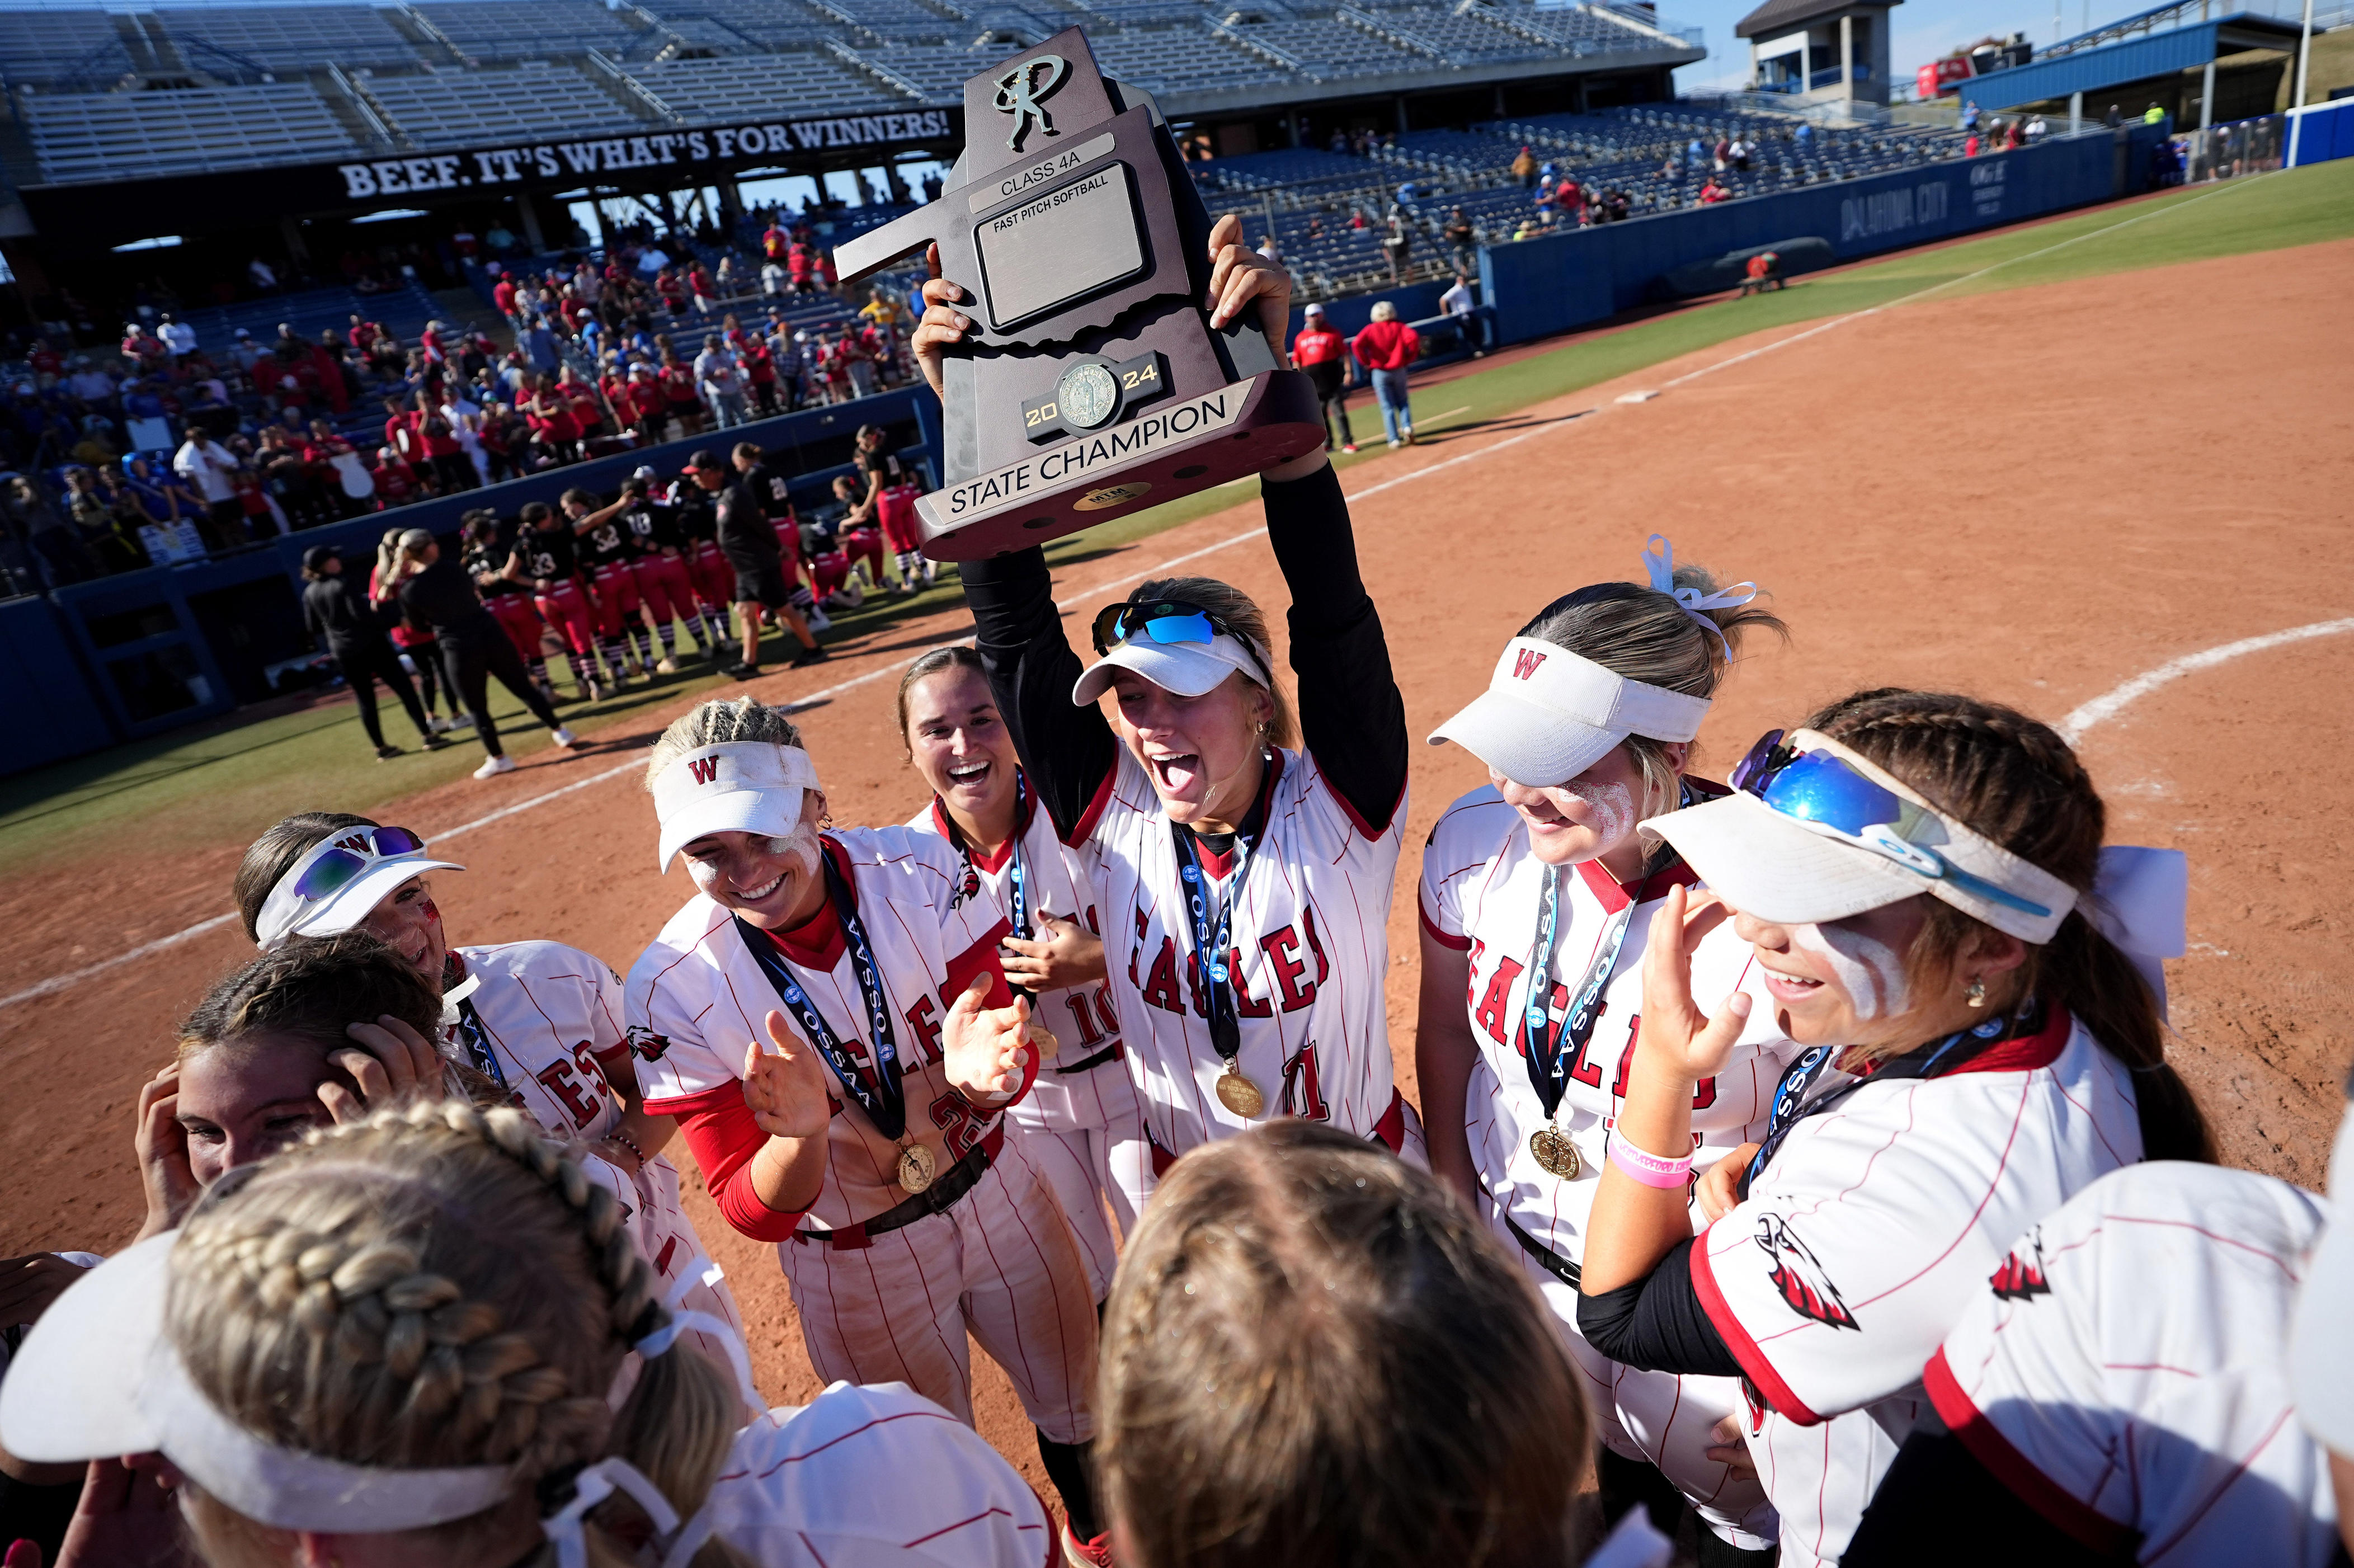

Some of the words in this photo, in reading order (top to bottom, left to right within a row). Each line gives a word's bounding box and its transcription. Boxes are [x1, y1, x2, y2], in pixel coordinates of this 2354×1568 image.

[341, 155, 472, 198] BEEF.
[473, 146, 559, 183] IT'S
[559, 131, 710, 173] WHAT'S
[713, 124, 793, 158] FOR
[790, 111, 950, 148] WINNERS!
[1002, 162, 1054, 196] CLASS
[1060, 152, 1080, 169] 4A
[994, 214, 1018, 233] FAST
[1021, 199, 1051, 220] PITCH
[1054, 176, 1108, 206] SOFTBALL
[1123, 364, 1157, 390] 24
[1025, 402, 1057, 427] 20
[951, 464, 1030, 514] STATE
[1040, 394, 1226, 480] CHAMPION
[1088, 488, 1127, 502] MTM
[1513, 648, 1547, 680] W
[689, 755, 719, 785] W
[334, 834, 371, 853] W
[848, 916, 886, 1033] OSSAA
[1551, 957, 1609, 1079] OSSAA
[803, 1011, 870, 1110] OSSAA
